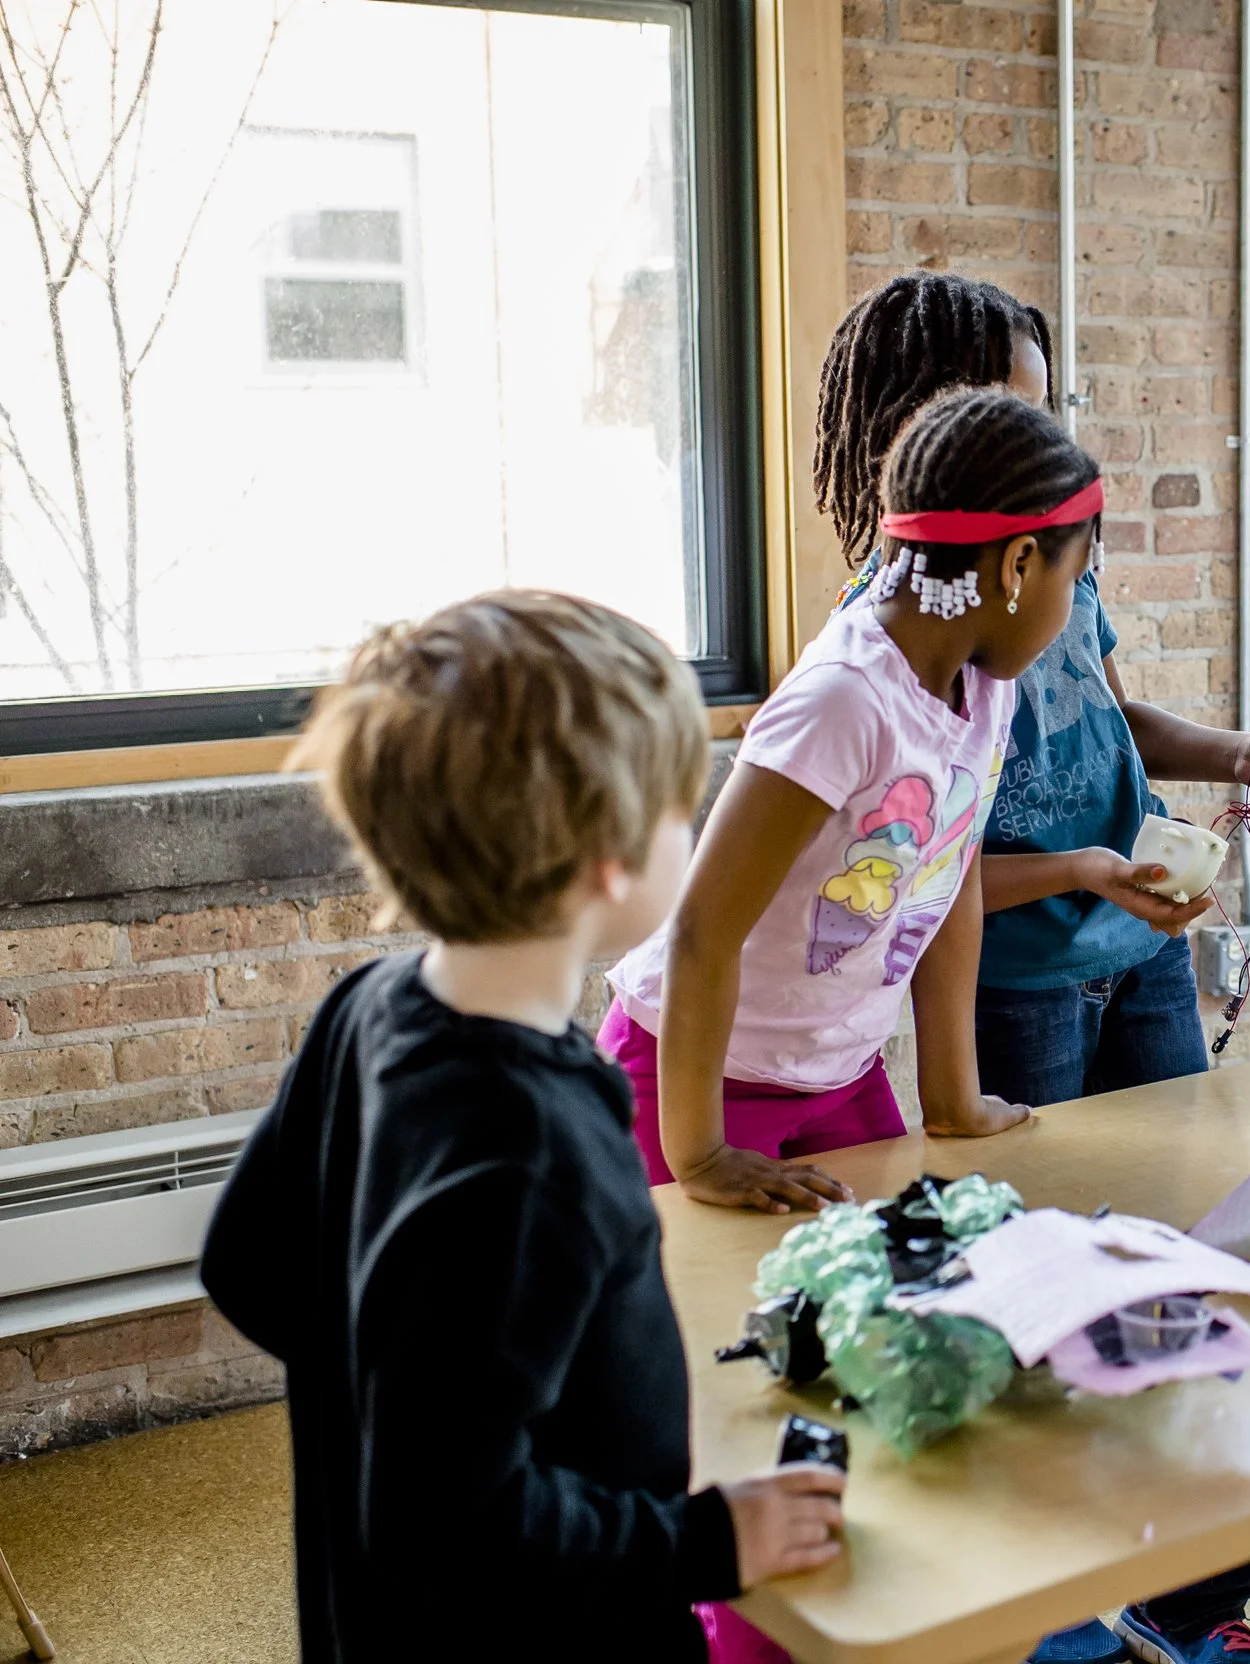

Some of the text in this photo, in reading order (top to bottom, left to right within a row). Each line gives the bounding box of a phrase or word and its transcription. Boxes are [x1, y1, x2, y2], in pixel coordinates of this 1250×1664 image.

[1002, 604, 1115, 761] BS
[995, 739, 1135, 819] BROADCASTIN
[998, 787, 1092, 842] SERVICE
